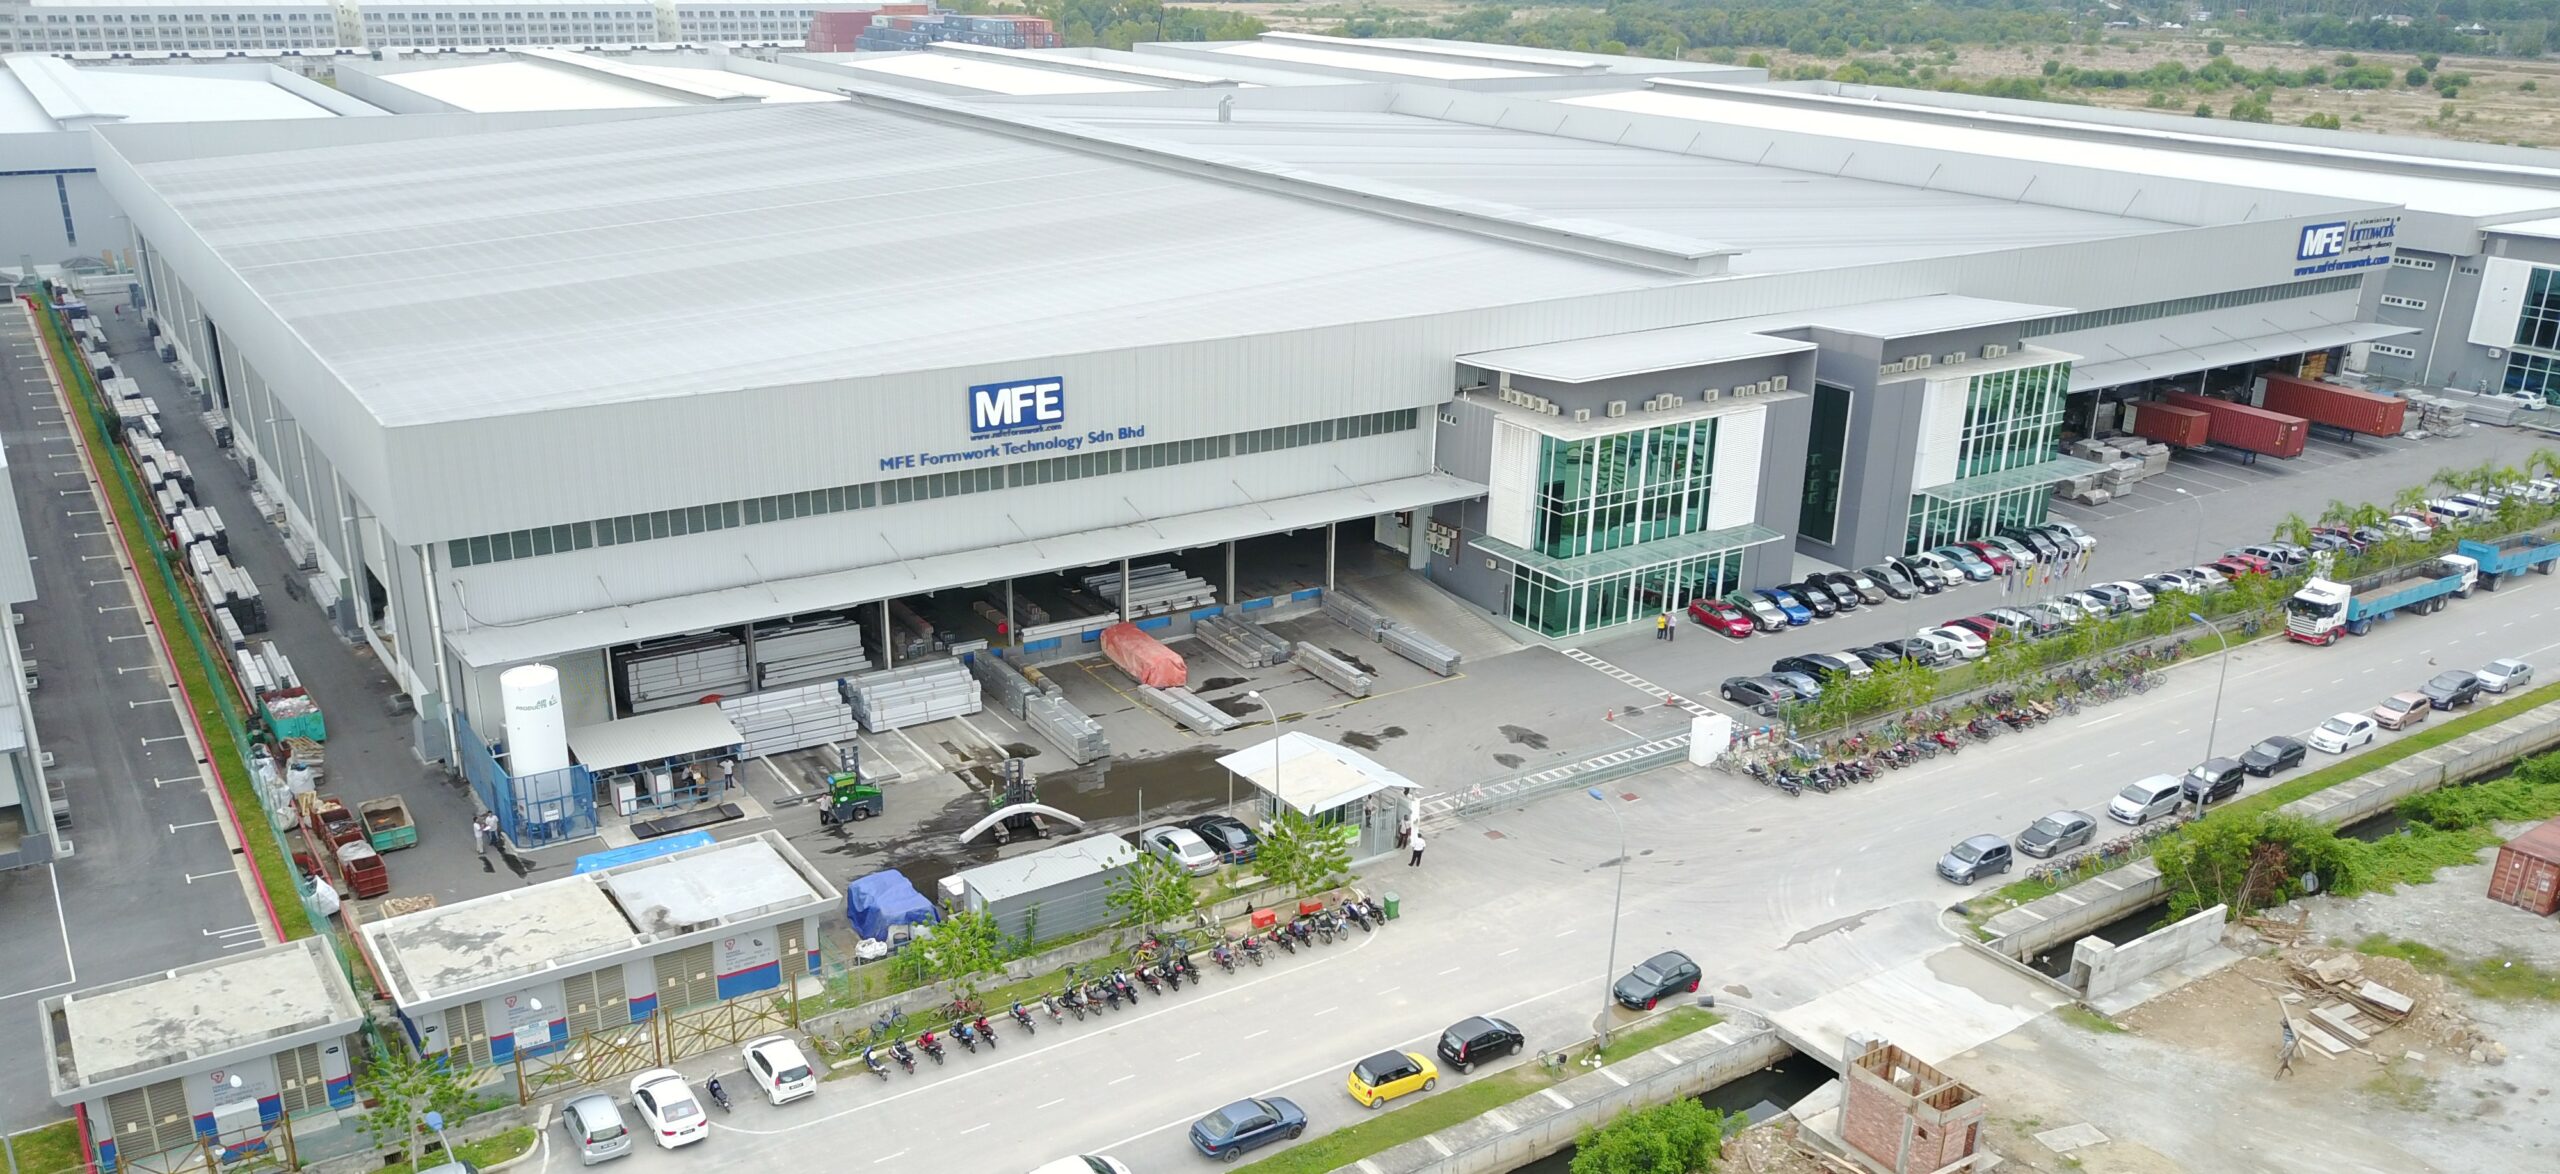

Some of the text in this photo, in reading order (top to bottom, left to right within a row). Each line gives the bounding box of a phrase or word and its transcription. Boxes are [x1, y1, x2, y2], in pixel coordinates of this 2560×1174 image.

[2302, 226, 2346, 257] MFE
[975, 383, 1062, 428] MFE
[880, 425, 1144, 471] MFE Formwork Technology Sdn Bhd
